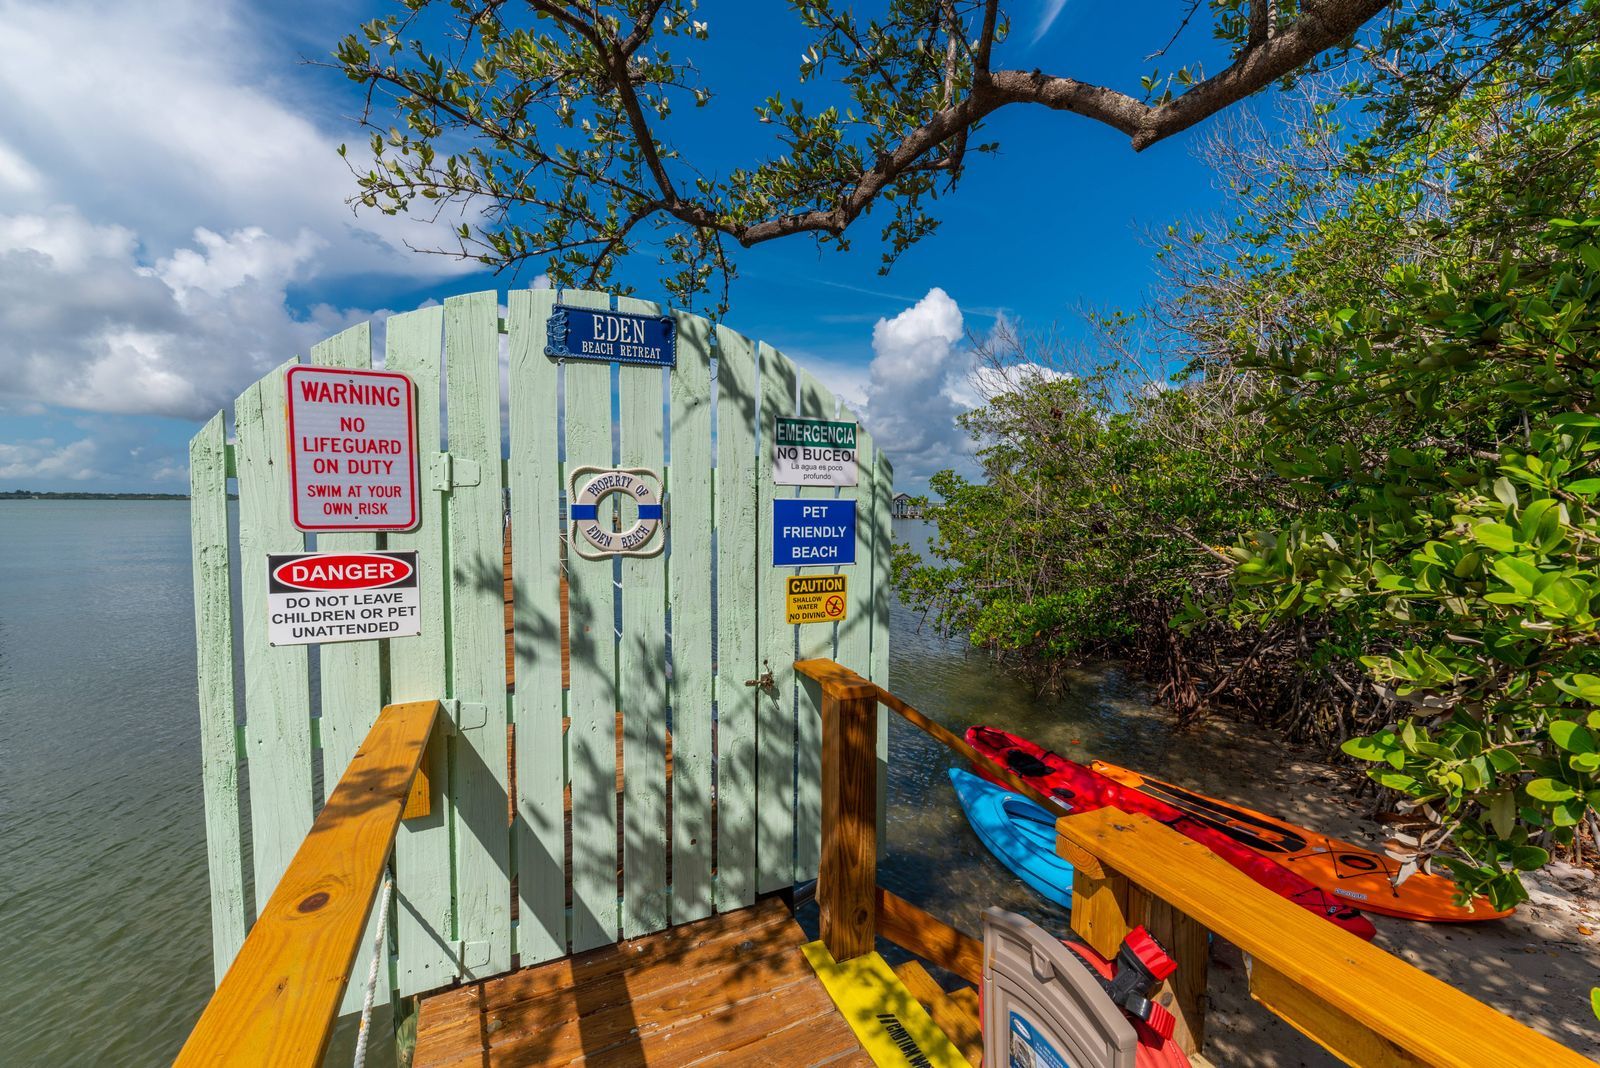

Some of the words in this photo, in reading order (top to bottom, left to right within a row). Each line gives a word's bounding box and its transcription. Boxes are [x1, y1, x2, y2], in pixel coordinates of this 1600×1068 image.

[592, 314, 646, 344] EDEN
[582, 341, 614, 355] BEACH
[620, 344, 661, 360] RETREAT
[301, 380, 400, 407] WARNING
[340, 417, 365, 433] NO
[777, 423, 855, 445] EMERGENCIA
[303, 436, 402, 455] LIFEGUARD
[777, 447, 798, 460] NO
[313, 458, 339, 474] ON
[348, 459, 394, 475] DUTY
[307, 484, 342, 498] SWIM
[348, 485, 362, 498] AT
[368, 485, 402, 498] YOUR
[587, 475, 634, 497] PROPERTY
[635, 484, 649, 497] OF
[323, 502, 353, 515] OWN
[358, 502, 388, 515] RISK
[803, 506, 828, 518] PET
[586, 525, 613, 548] EDEN
[620, 525, 650, 549] BEACH
[783, 526, 847, 538] FRIENDLY
[792, 546, 838, 558] BEACH
[291, 563, 396, 582] DANGER
[791, 579, 843, 593] CAUTION
[286, 597, 311, 609] DO
[315, 595, 349, 607] NOT
[354, 592, 404, 605] LEAVE
[792, 596, 823, 604] SHALLOW
[272, 609, 355, 625] CHILDREN
[360, 607, 383, 619] OR
[388, 606, 417, 618] PET
[789, 612, 800, 621] NO
[802, 611, 826, 619] DIVING
[292, 621, 400, 638] UNATTENDED
[886, 1023, 922, 1058] CAUTION
